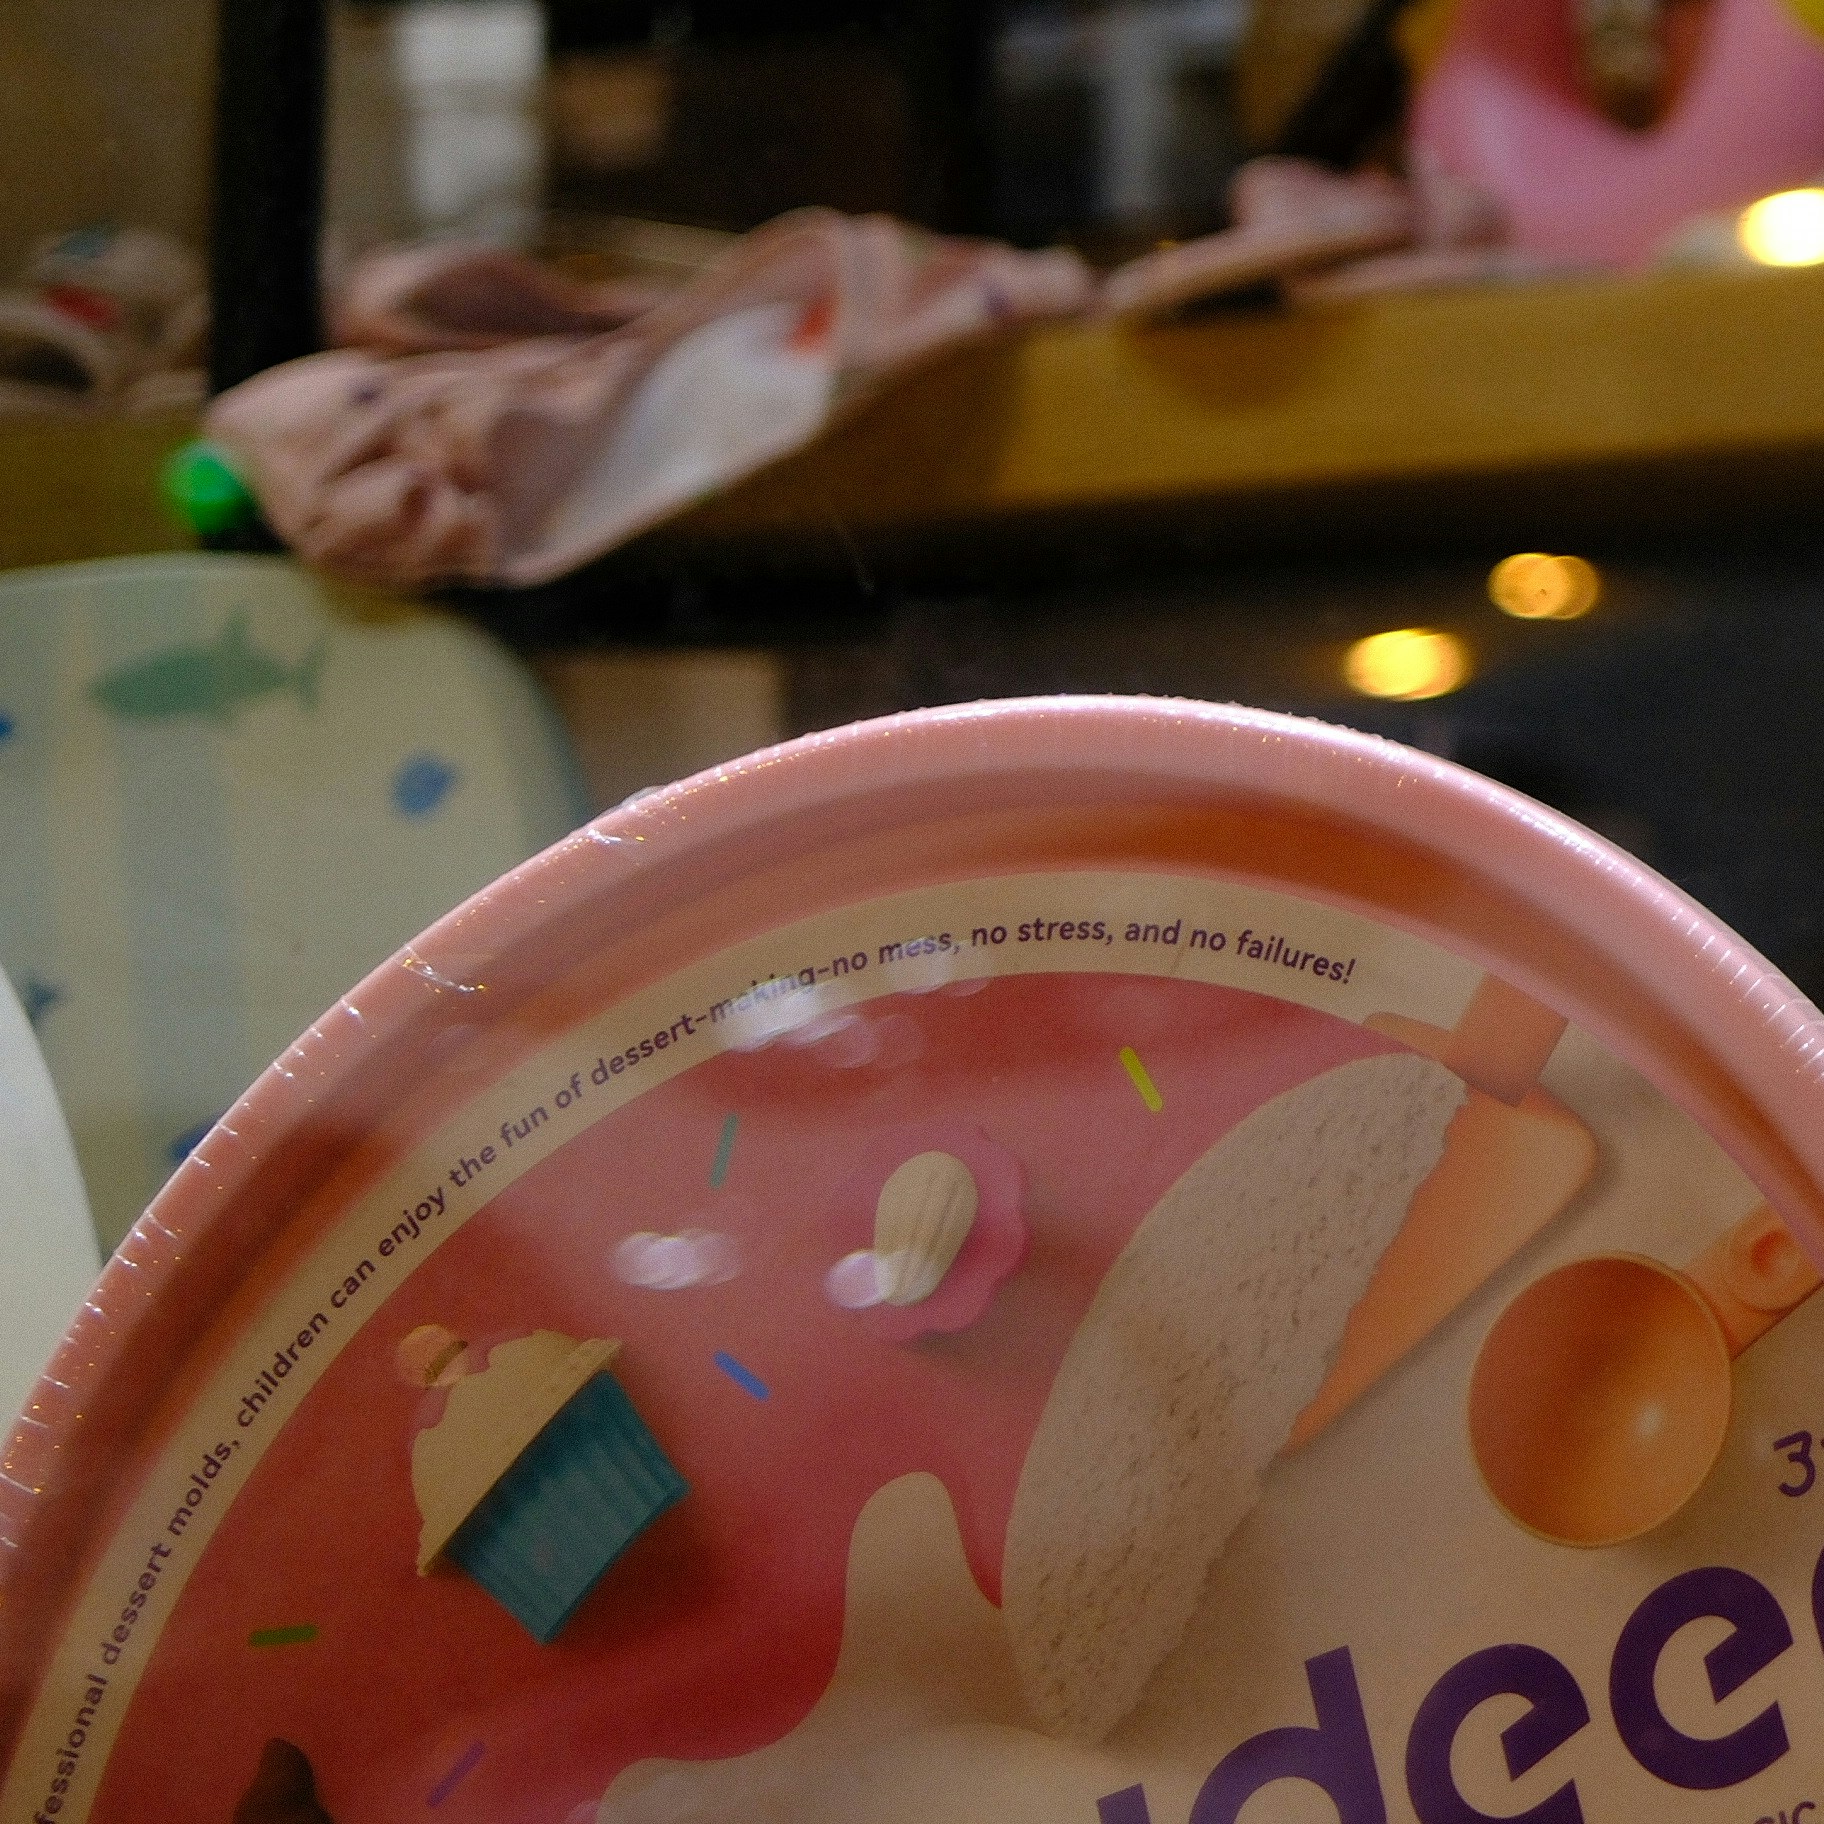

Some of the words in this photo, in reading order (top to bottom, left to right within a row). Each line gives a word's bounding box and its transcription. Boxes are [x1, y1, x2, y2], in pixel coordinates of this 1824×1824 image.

[102, 1542, 172, 1665] dessert
[167, 1440, 240, 1536] molds,
[237, 1312, 330, 1427] children
[330, 1259, 376, 1308] can
[378, 1186, 445, 1257] enjoy
[449, 1145, 497, 1187] the
[500, 1106, 549, 1148] fun
[554, 1072, 583, 1109] of
[879, 932, 960, 964] mess,
[971, 926, 1007, 946] no
[1018, 917, 1114, 945] stress,
[1124, 919, 1183, 945] and
[1189, 928, 1227, 951] no
[1237, 930, 1357, 984] failures!
